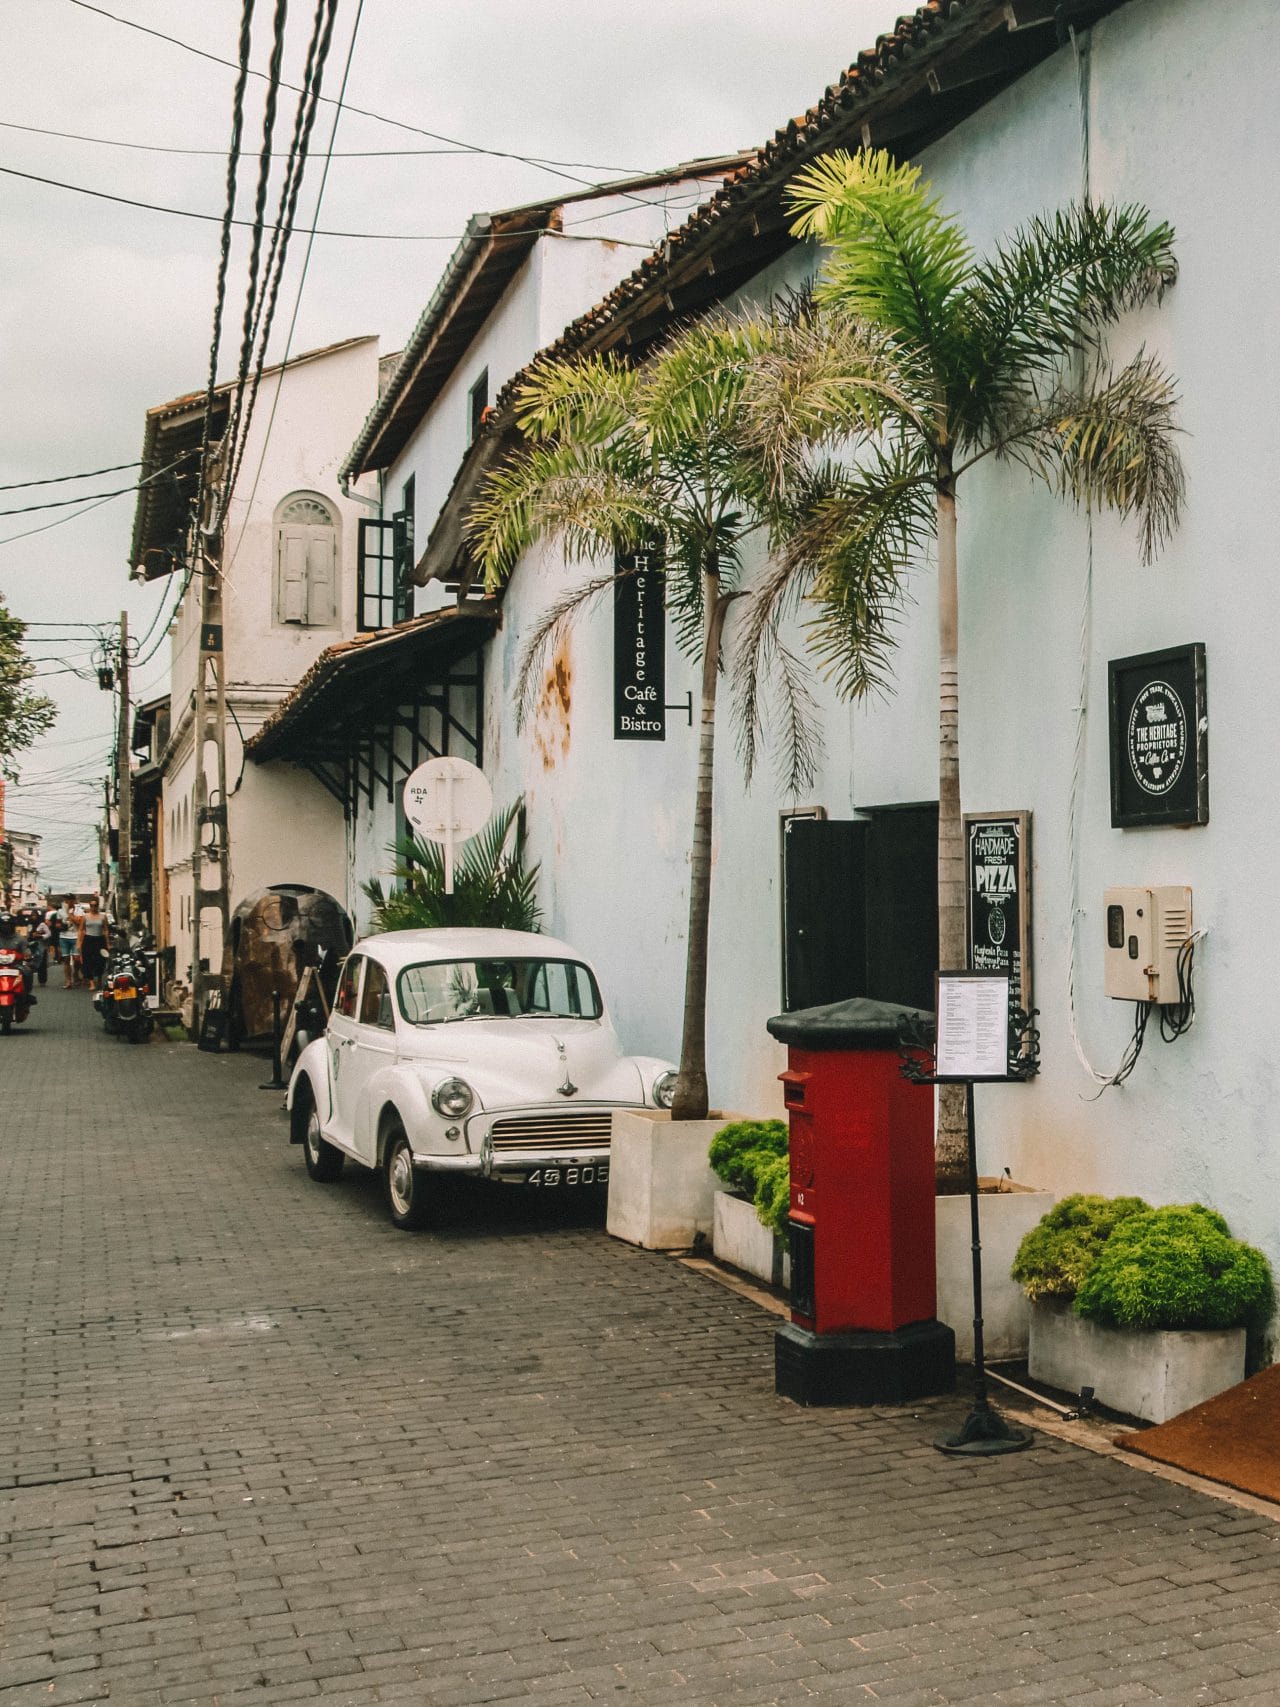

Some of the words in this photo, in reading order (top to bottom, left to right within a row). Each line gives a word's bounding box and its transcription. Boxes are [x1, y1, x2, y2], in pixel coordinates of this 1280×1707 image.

[634, 556, 649, 681] Heritage
[624, 685, 657, 701] Café
[635, 704, 646, 715] &
[621, 716, 661, 731] Bistro
[1136, 727, 1148, 742] THE
[1149, 723, 1178, 741] HERITAGE
[1136, 739, 1177, 751] PROPRIETORS
[975, 837, 1015, 855] HANDMADE
[984, 856, 1007, 865] FRESH
[975, 865, 1017, 892] PIZZA
